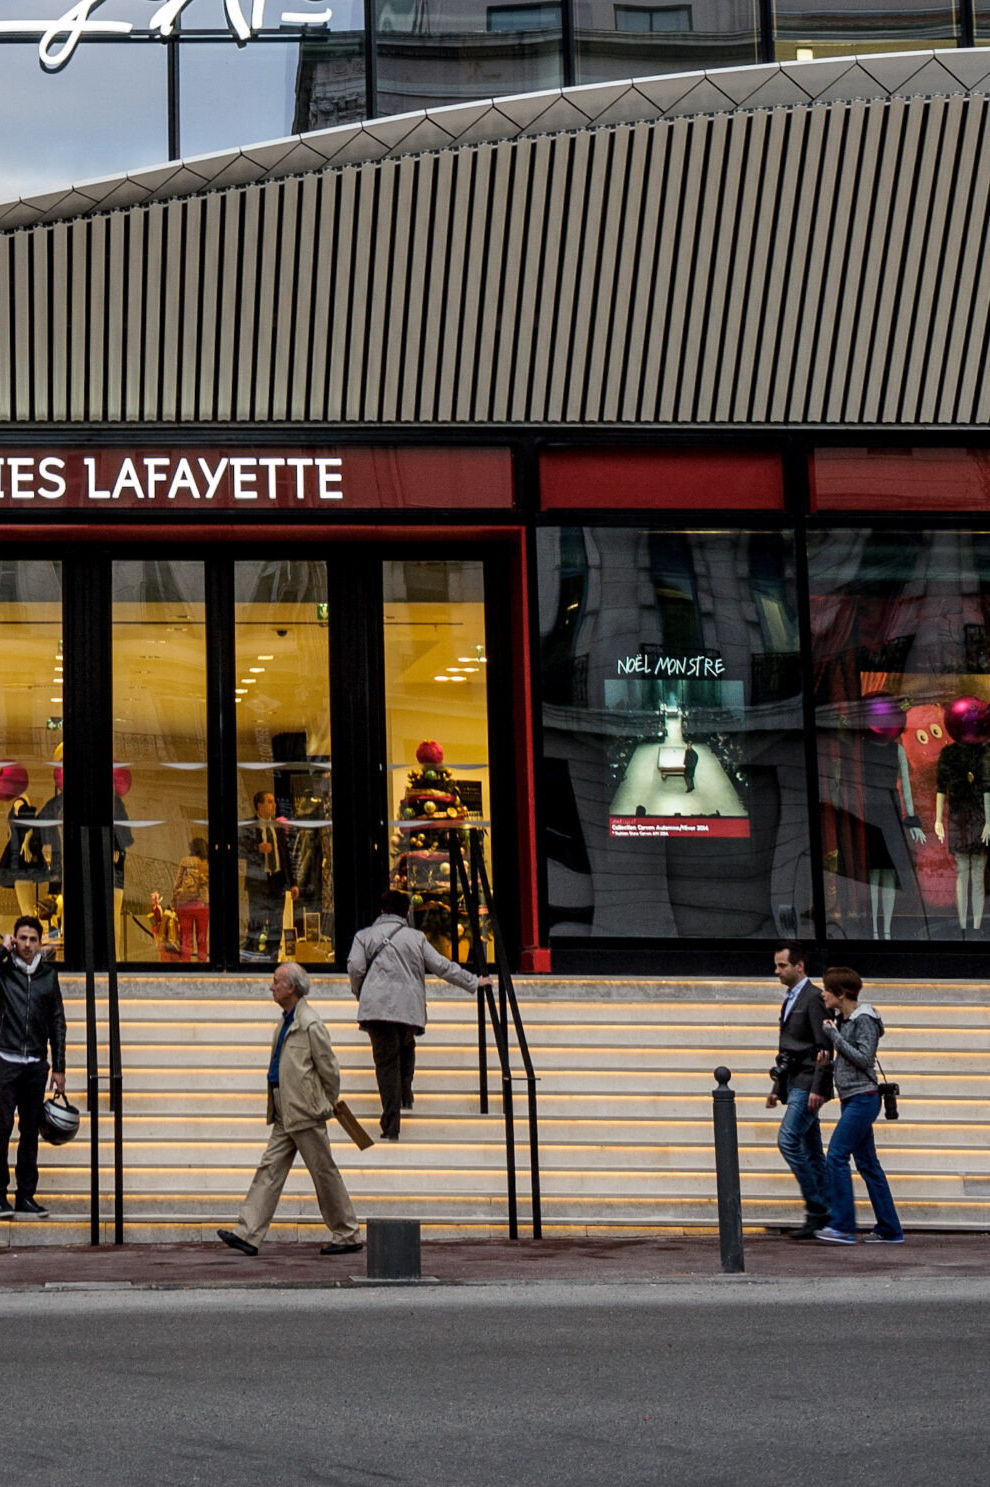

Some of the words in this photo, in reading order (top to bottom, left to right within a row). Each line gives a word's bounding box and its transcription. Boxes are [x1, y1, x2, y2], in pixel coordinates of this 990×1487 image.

[88, 457, 343, 499] LAFAYETTE
[617, 654, 651, 674] NOËL
[654, 656, 725, 677] MONSTRE
